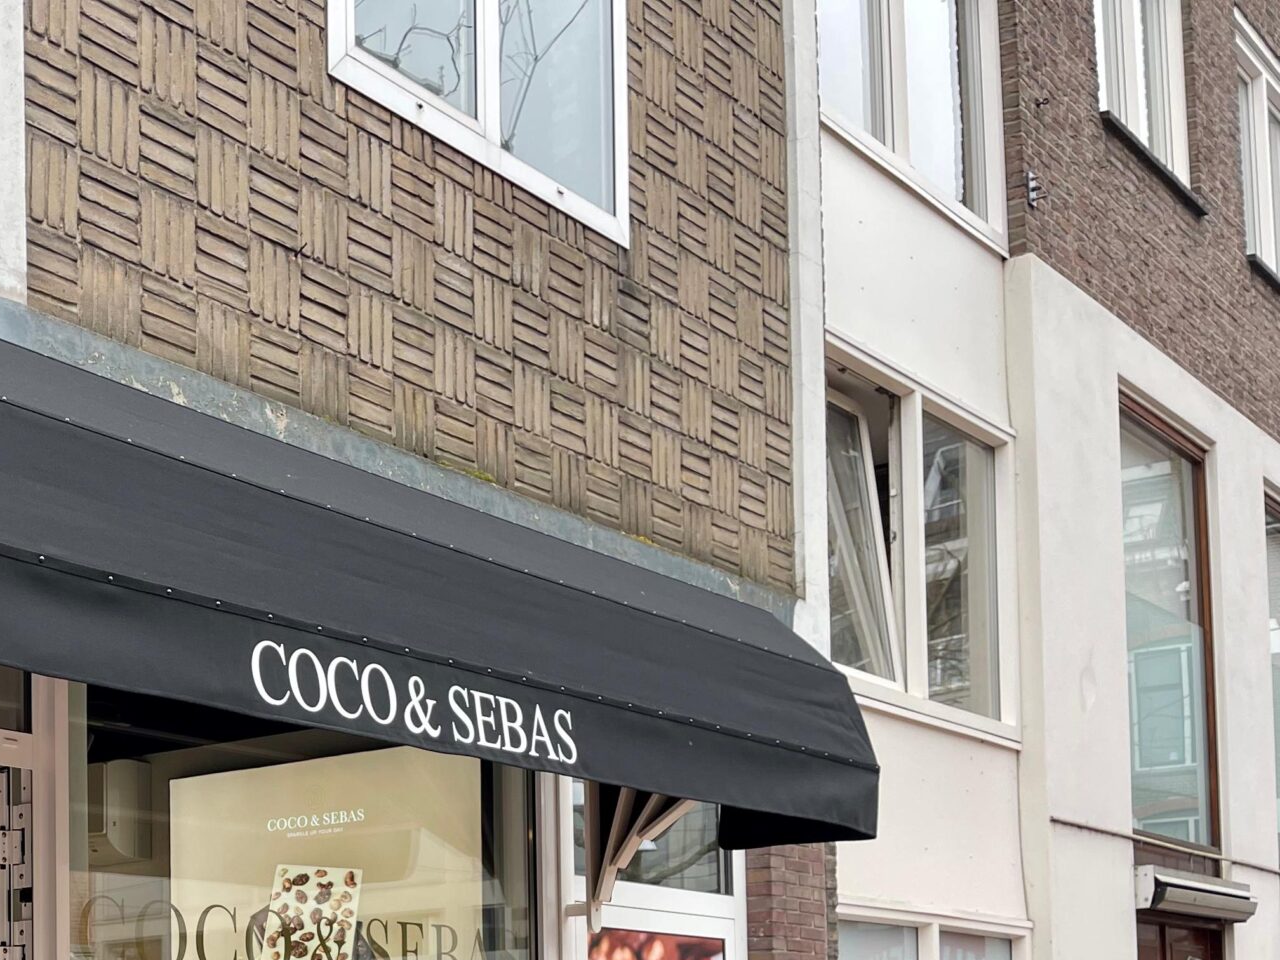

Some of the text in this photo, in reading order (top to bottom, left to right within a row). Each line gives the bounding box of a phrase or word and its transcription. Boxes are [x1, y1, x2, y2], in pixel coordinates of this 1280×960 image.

[251, 639, 578, 764] COCO & SEBAS
[267, 808, 365, 832] COCO & SEBAS
